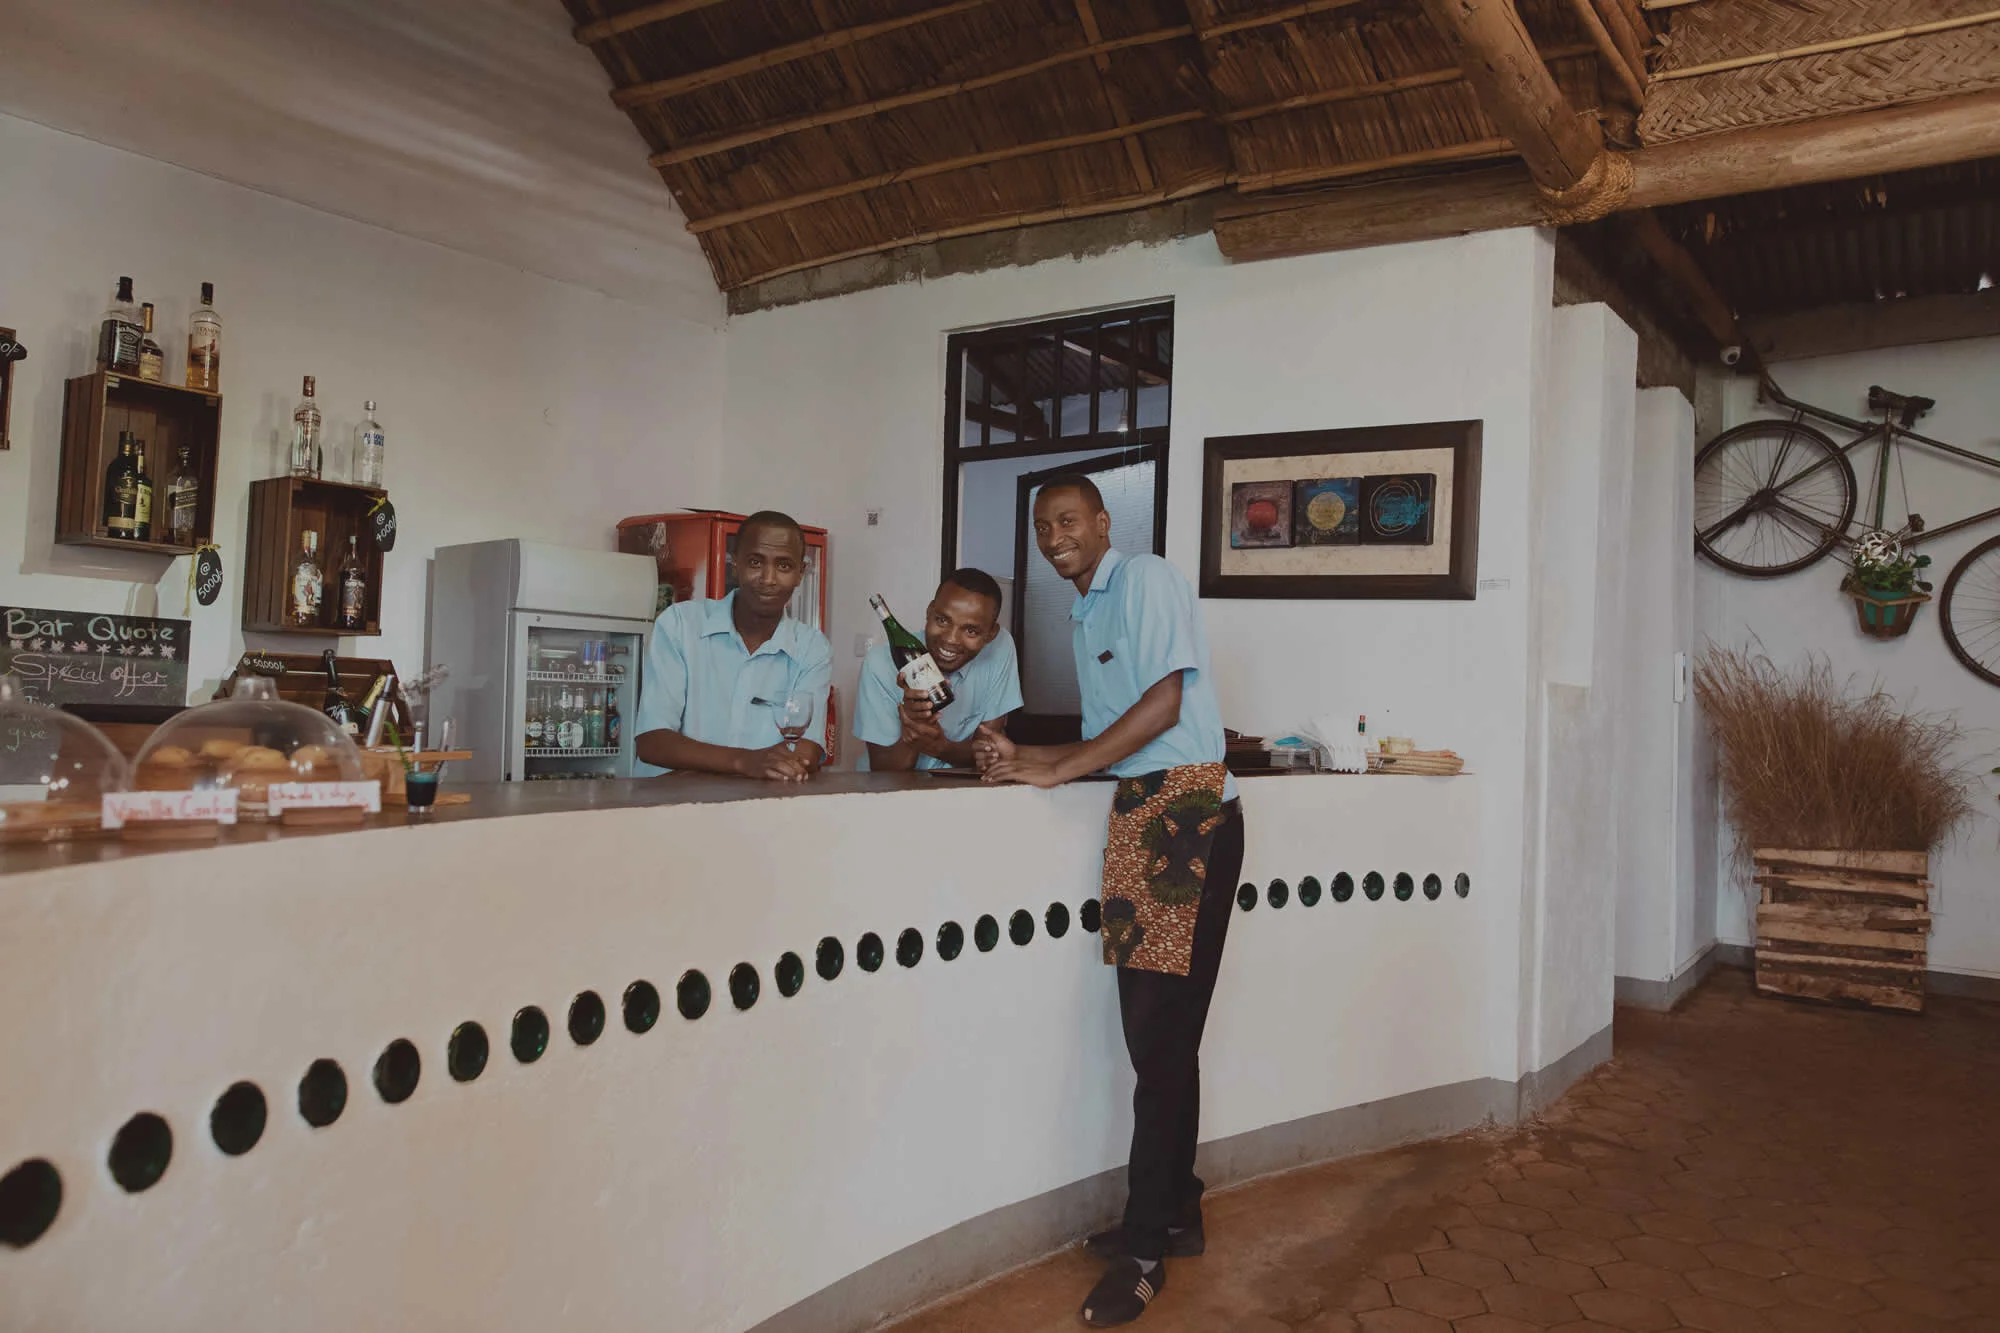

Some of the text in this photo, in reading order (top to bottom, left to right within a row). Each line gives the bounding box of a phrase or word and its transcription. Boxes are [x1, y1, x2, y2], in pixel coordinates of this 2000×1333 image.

[200, 562, 211, 576] @
[3, 609, 175, 642] Bar Quote
[10, 650, 168, 697] Special offer
